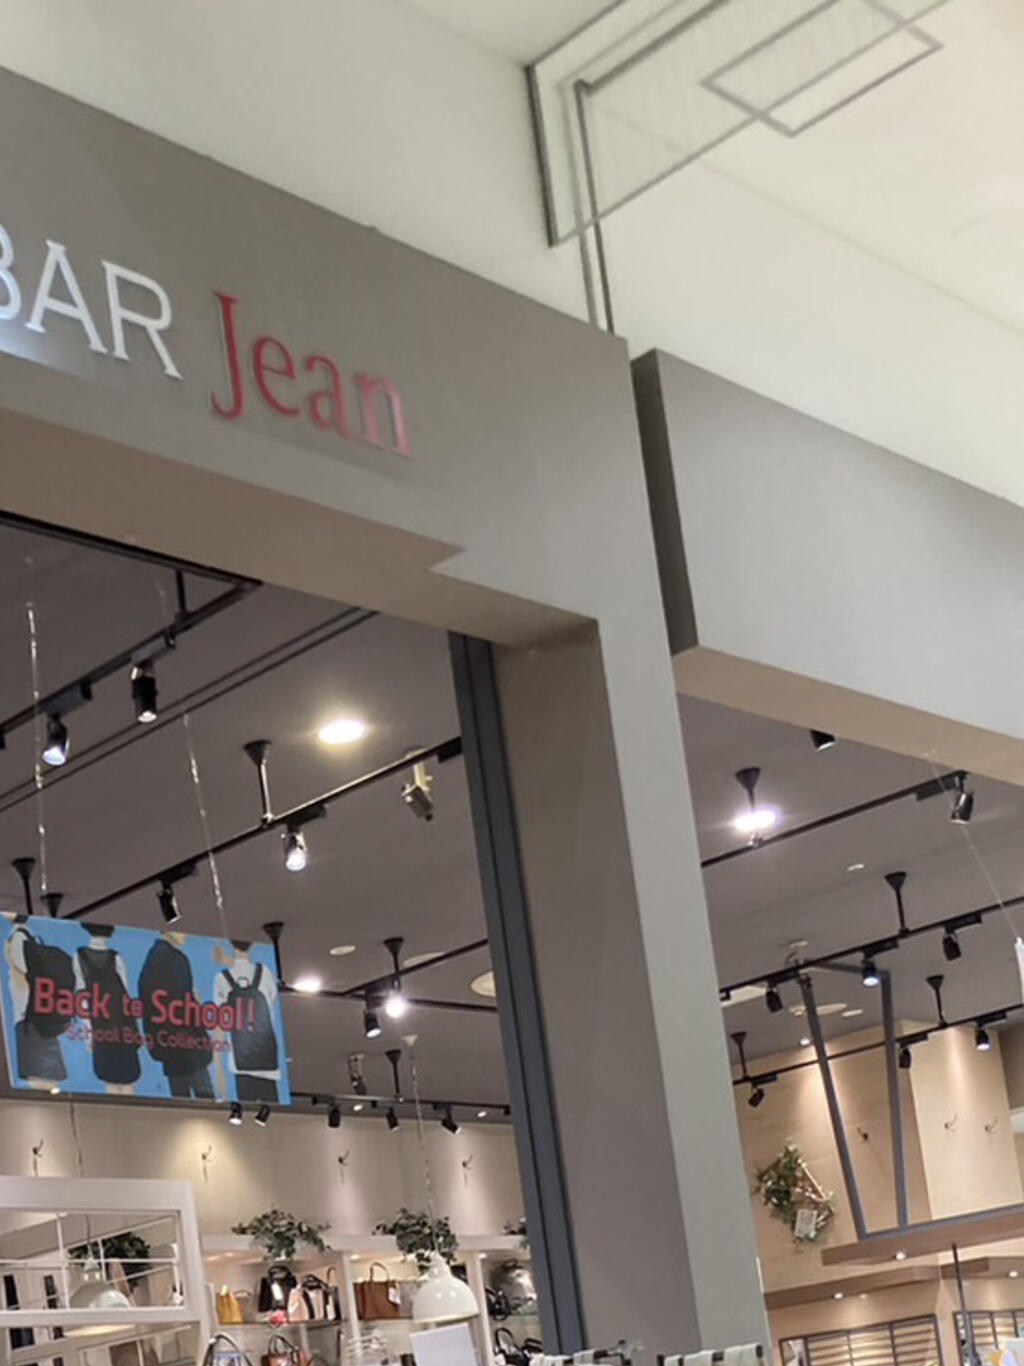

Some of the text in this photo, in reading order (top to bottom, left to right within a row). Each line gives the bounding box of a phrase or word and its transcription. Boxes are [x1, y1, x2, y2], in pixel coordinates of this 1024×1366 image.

[208, 290, 413, 459] Jean
[34, 976, 256, 1032] Back to School!
[66, 1022, 121, 1044] School
